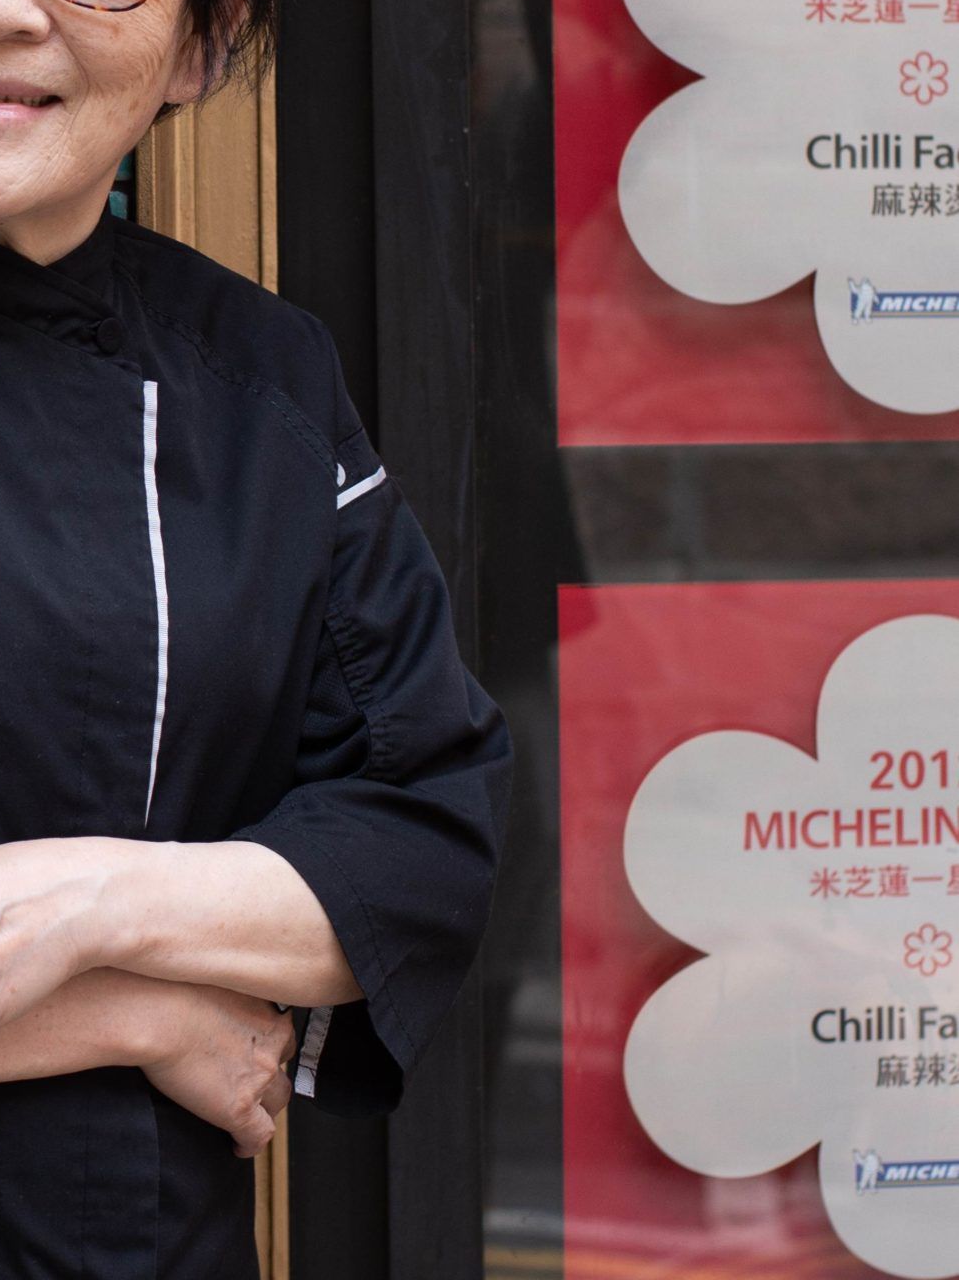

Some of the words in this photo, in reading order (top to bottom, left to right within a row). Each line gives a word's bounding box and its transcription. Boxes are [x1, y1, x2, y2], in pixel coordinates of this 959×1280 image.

[806, 133, 902, 170] Chilli
[914, 135, 959, 170] Fa
[879, 296, 959, 312] MICHE
[870, 749, 959, 791] 201
[743, 805, 959, 852] MICHELIN
[811, 1006, 906, 1044] Chilli
